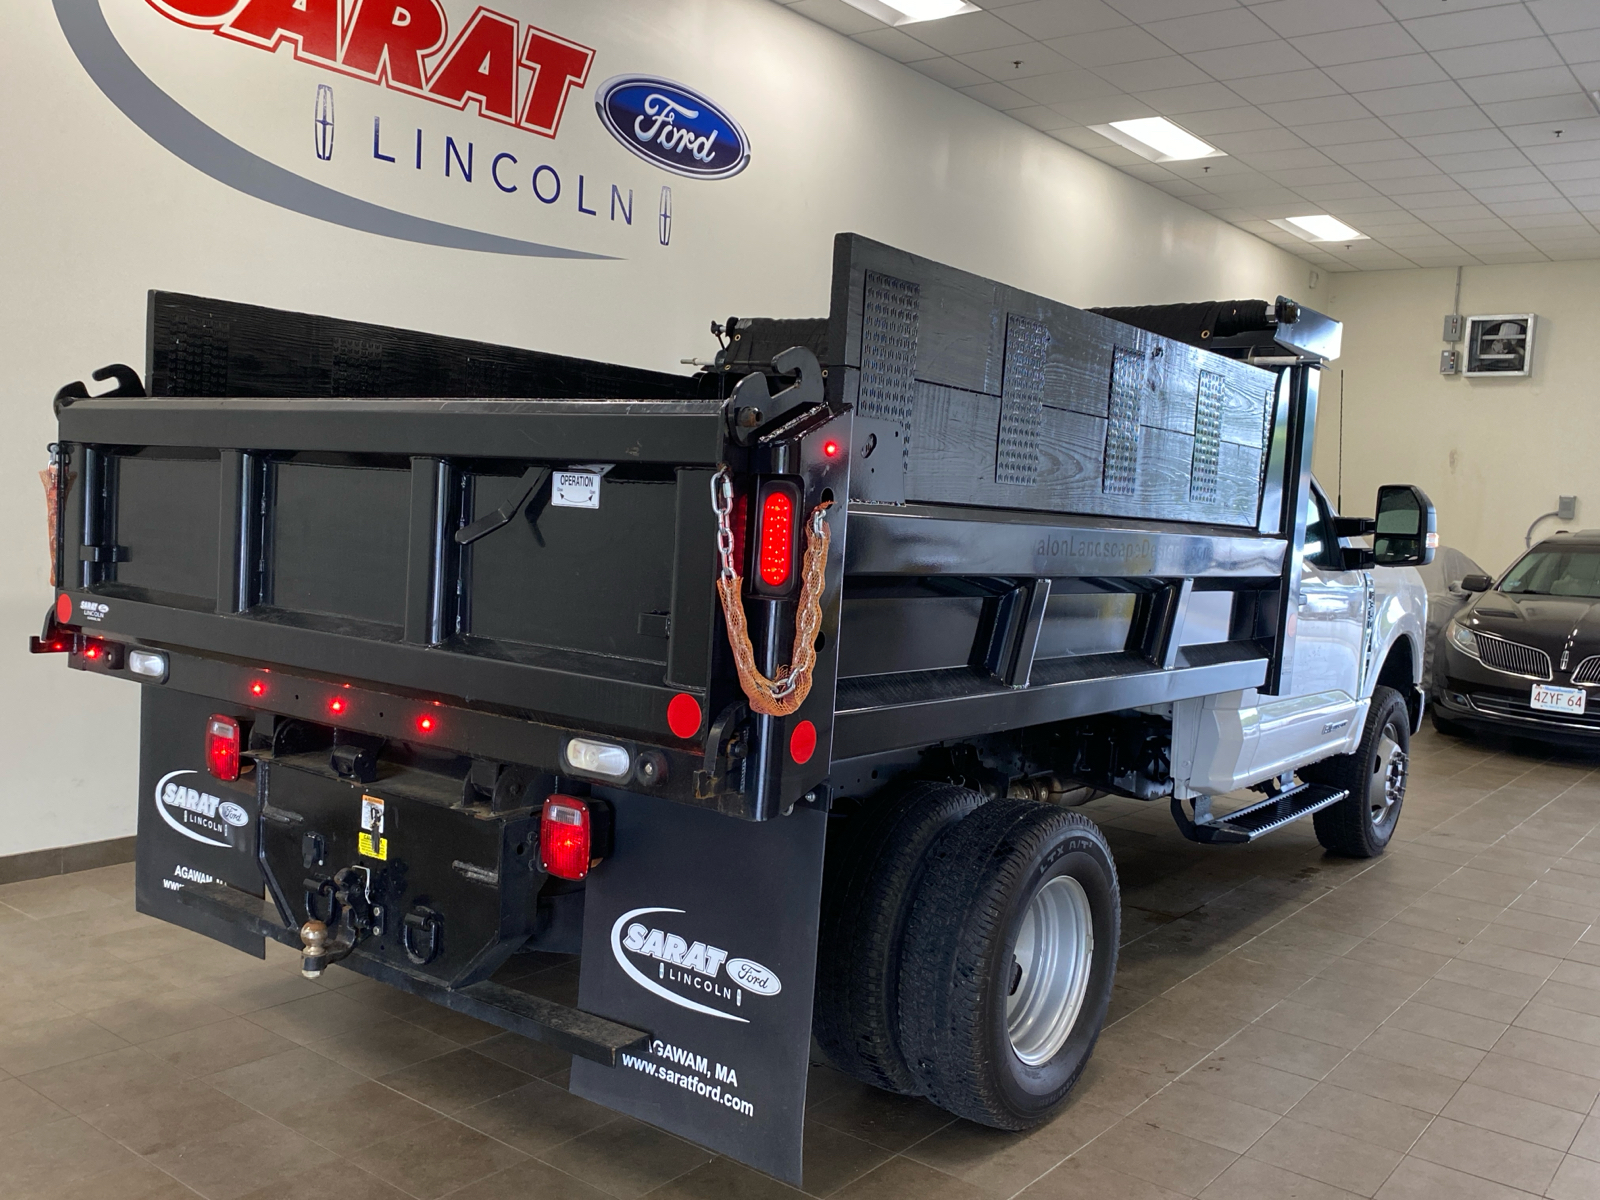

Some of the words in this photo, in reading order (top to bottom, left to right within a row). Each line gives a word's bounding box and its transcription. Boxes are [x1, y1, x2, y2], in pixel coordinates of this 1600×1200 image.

[145, 0, 597, 139] ARAT
[634, 93, 719, 163] Ford
[373, 115, 633, 225] LINCOLN
[560, 474, 594, 488] OPERATION
[1534, 691, 1563, 706] 4ZYF
[1567, 695, 1582, 708] 64
[162, 782, 220, 818] SARAT
[224, 805, 243, 822] Ford
[189, 814, 223, 833] LINCOLN
[622, 922, 728, 978] SARAT
[669, 970, 732, 1000] LINCOLN
[737, 962, 769, 990] Ford
[622, 1053, 754, 1117] www.saratford.com
[714, 1062, 738, 1087] MA
